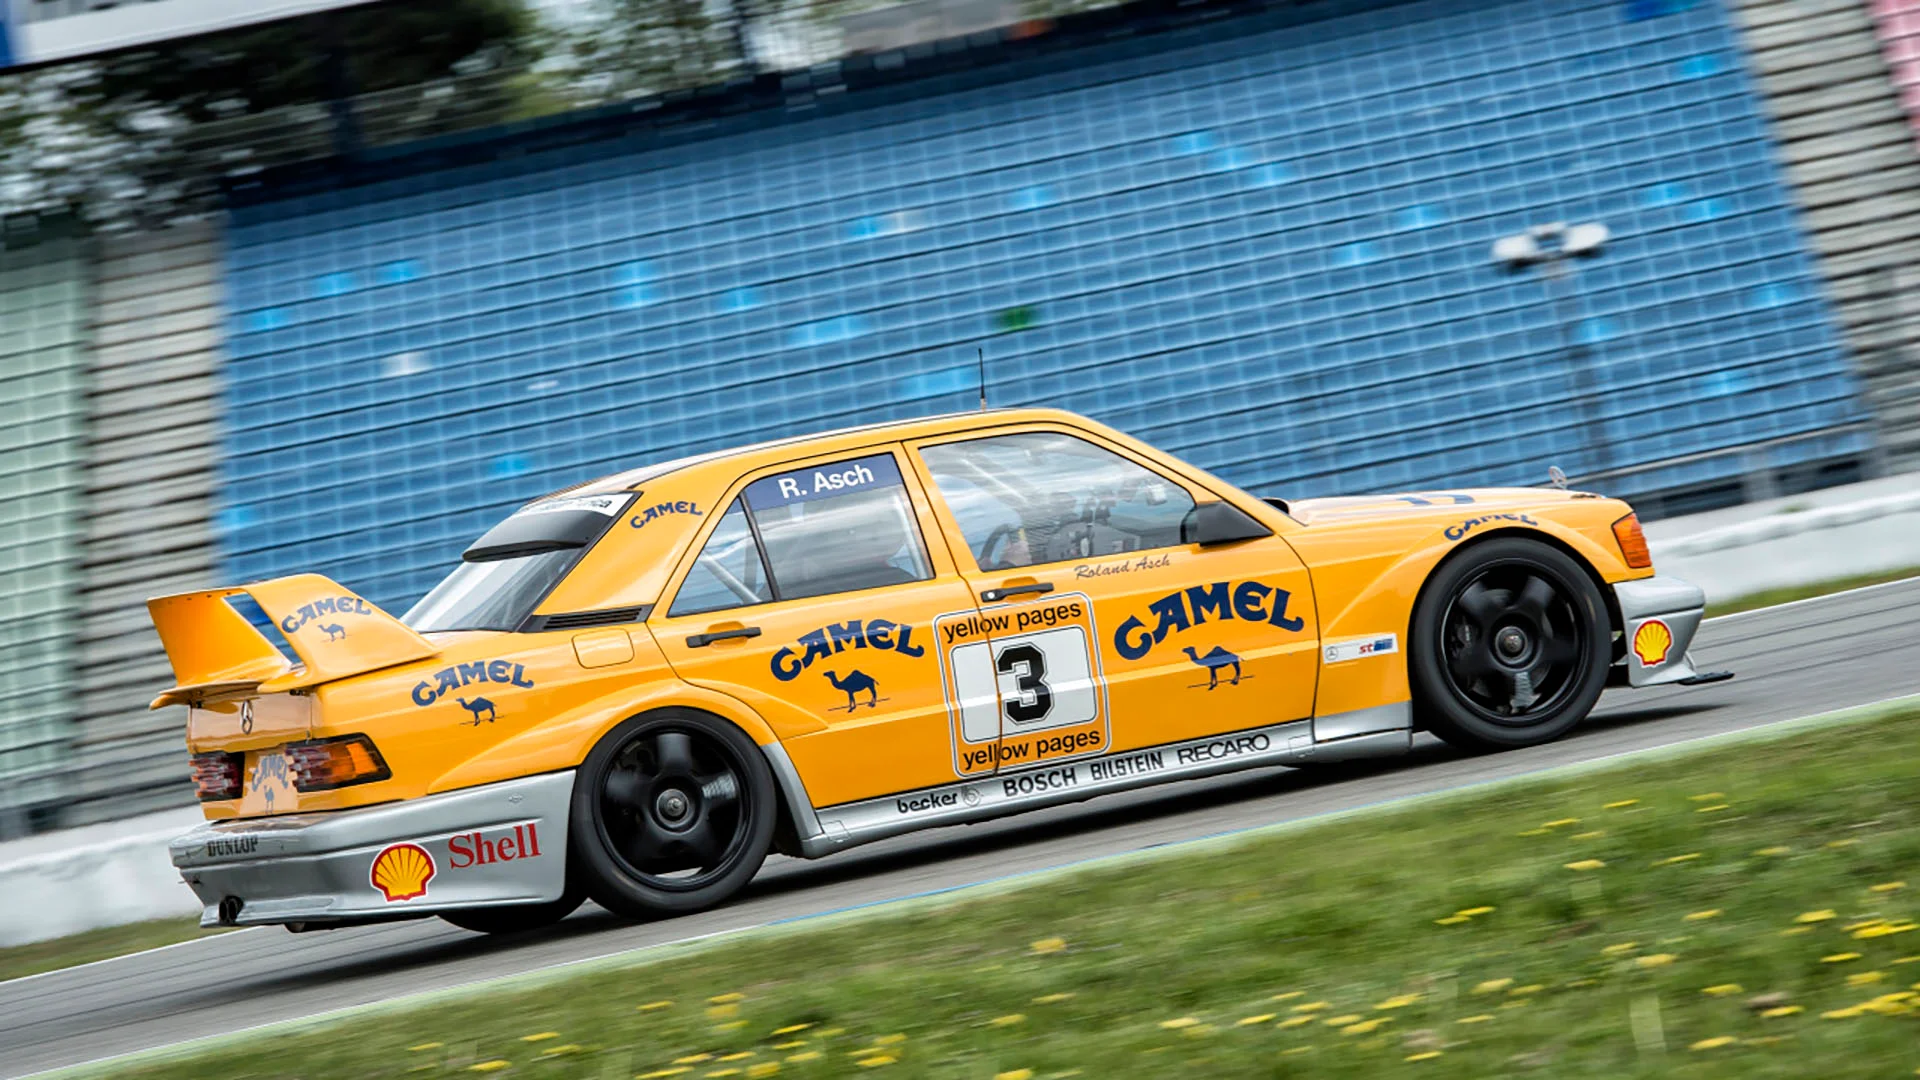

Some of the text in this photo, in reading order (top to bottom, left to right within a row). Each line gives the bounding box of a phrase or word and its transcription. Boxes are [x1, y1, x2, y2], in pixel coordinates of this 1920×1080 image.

[778, 464, 874, 499] R. Asch
[630, 501, 703, 529] CAMEL
[1074, 554, 1171, 580] Roland Asch
[281, 596, 372, 634] CAMEL
[943, 601, 1082, 643] yellow pages
[1113, 581, 1304, 660] CAMEL
[770, 619, 925, 681] CAMEL
[412, 660, 535, 706] CAMEL
[996, 643, 1056, 724] 3
[963, 728, 1101, 770] yellow pages
[897, 733, 1270, 814] becker BOSCH BILSTEIN RECARO
[207, 834, 258, 857] DUNLOP
[448, 824, 541, 870] Shell
